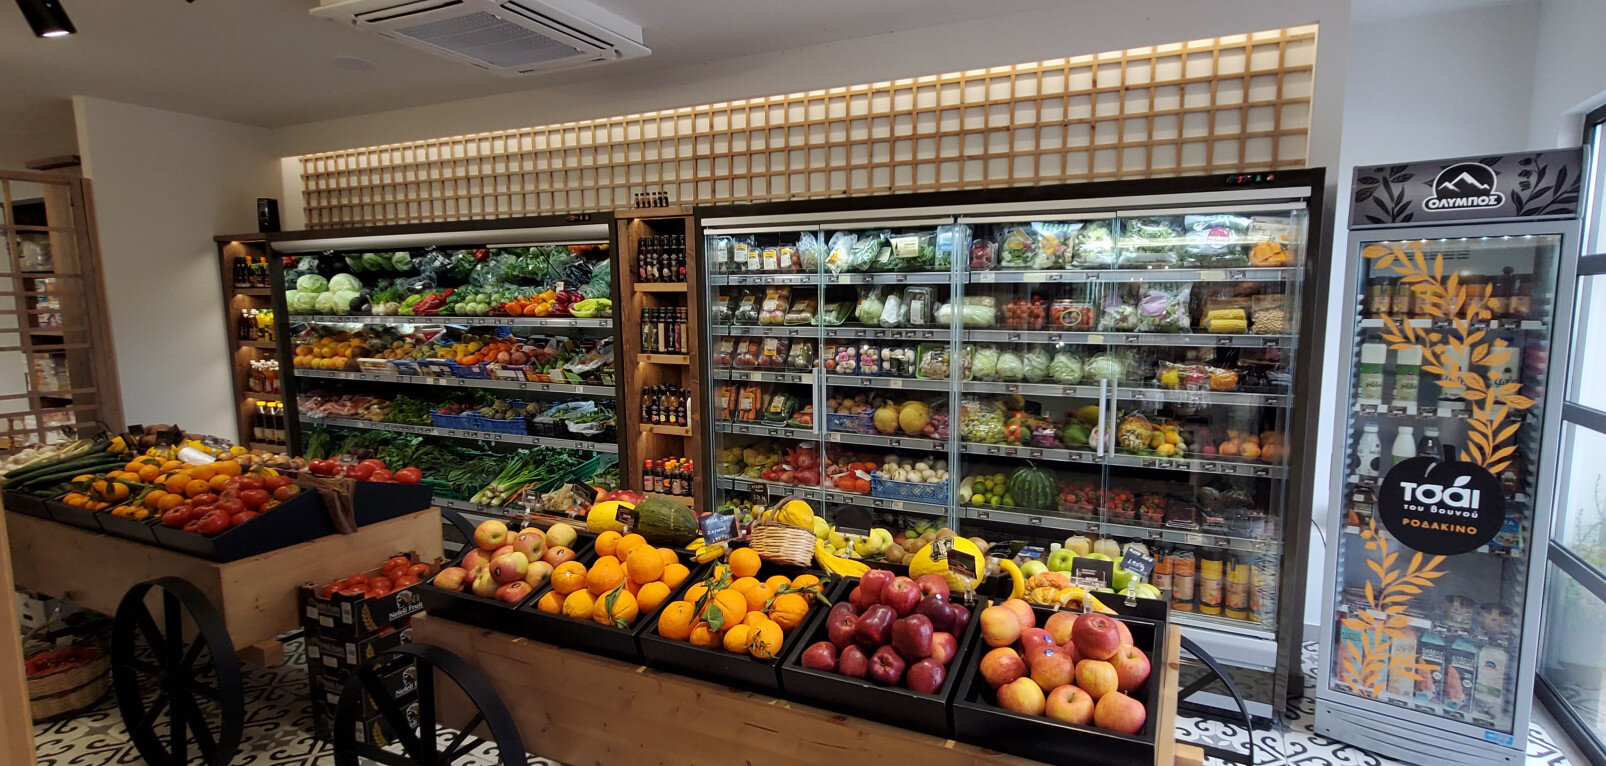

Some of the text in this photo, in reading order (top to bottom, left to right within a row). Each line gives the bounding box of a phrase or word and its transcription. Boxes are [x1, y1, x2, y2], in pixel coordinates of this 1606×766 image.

[1428, 195, 1498, 209] ΟΛΥΜΠΟΣ
[1403, 504, 1424, 512] του
[1402, 517, 1478, 535] ΡΟΔΑΚΙΝΟ
[388, 601, 424, 620] Nefeli Fruit
